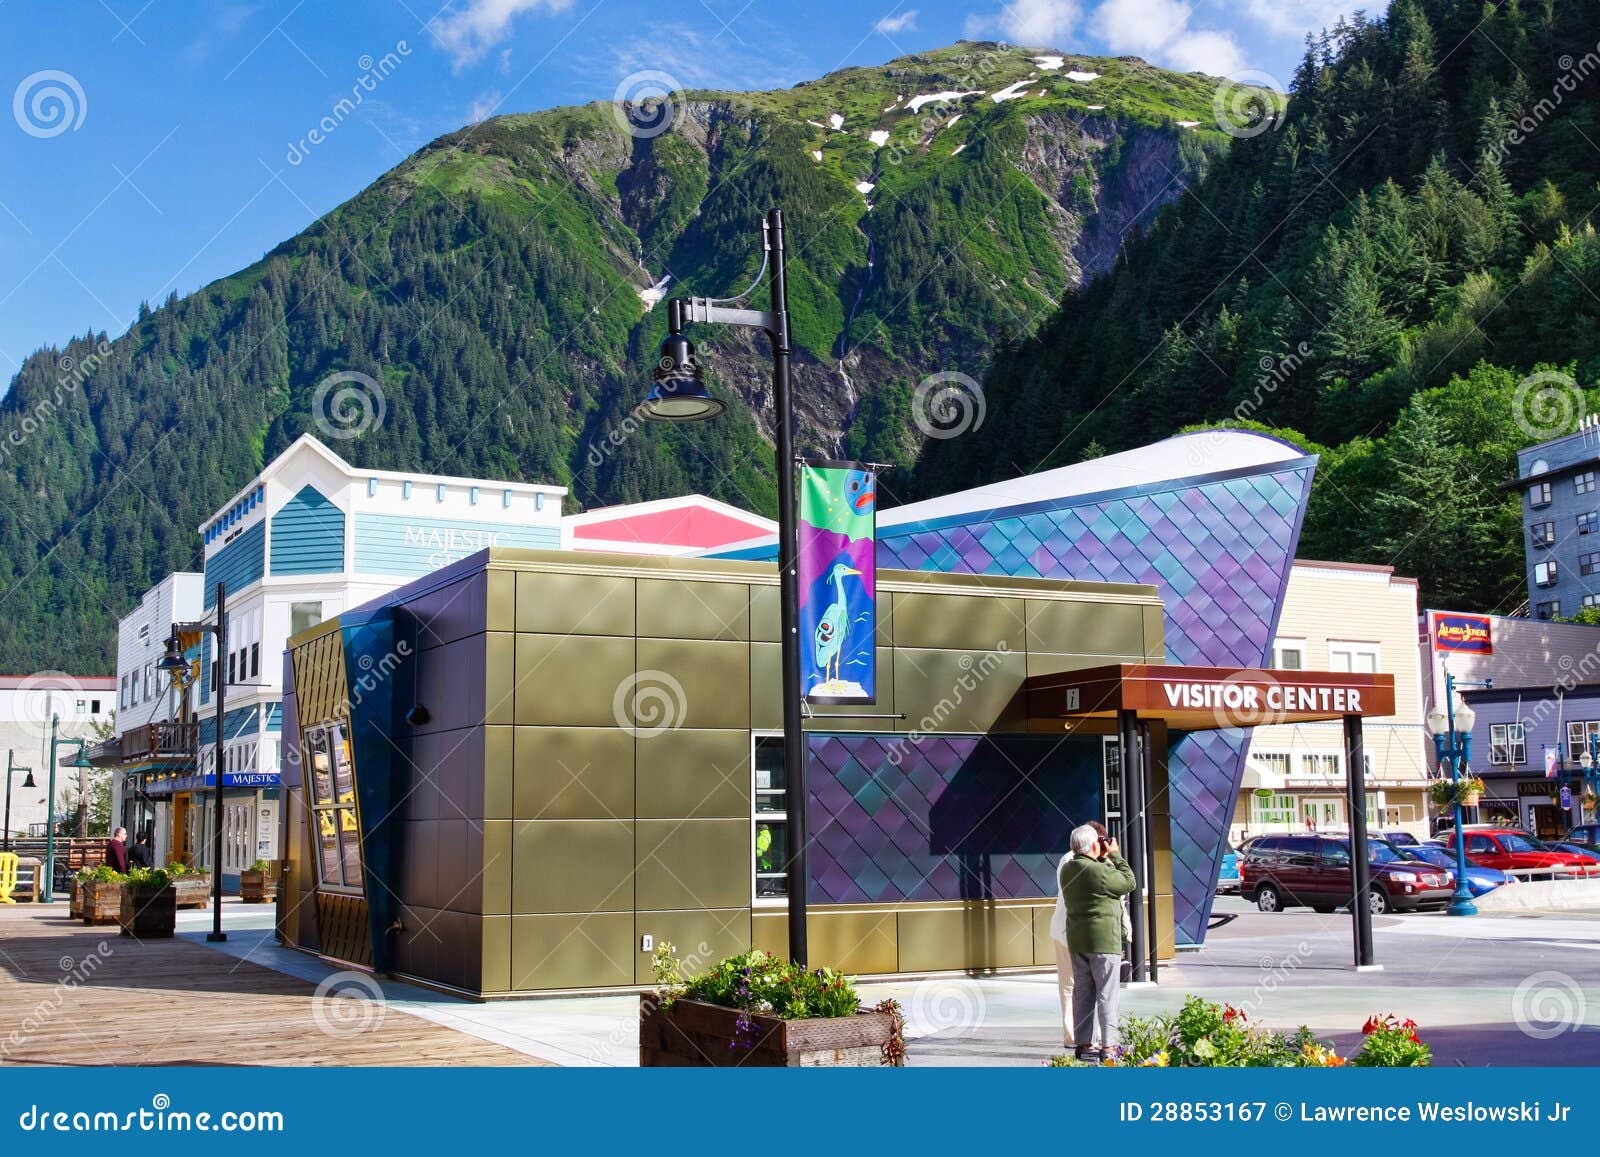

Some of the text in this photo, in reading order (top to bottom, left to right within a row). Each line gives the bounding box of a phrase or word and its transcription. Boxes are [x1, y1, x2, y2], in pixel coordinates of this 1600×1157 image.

[1163, 683, 1363, 712] VISITOR CENTER
[232, 774, 277, 785] MAJESTIC
